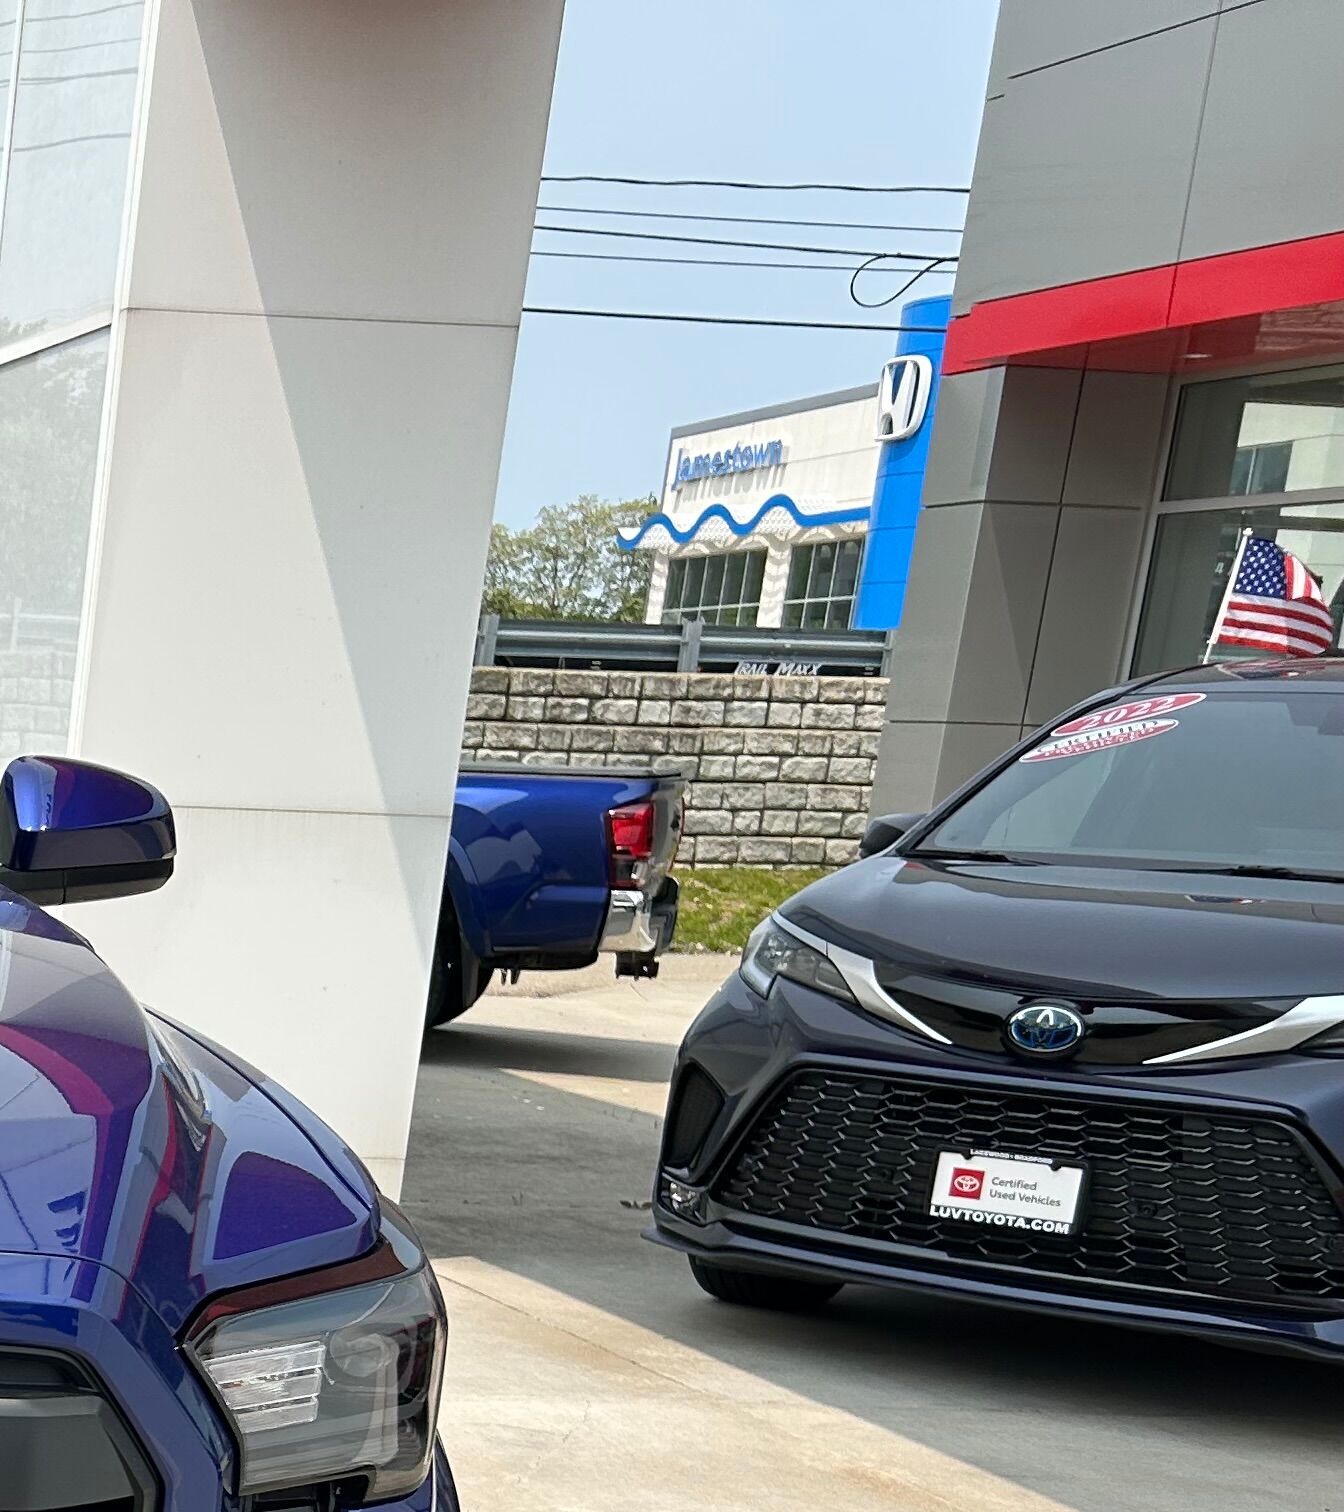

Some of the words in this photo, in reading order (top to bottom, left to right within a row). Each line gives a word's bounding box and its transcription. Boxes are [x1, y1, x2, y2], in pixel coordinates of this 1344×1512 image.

[671, 440, 783, 491] Jamestown
[1079, 697, 1175, 727] 2022
[989, 1188, 1016, 1201] Used
[1019, 1190, 1061, 1207] Vehicles
[991, 1176, 1038, 1191] Certified
[929, 1204, 1070, 1235] LUVTOYOTA.COM
